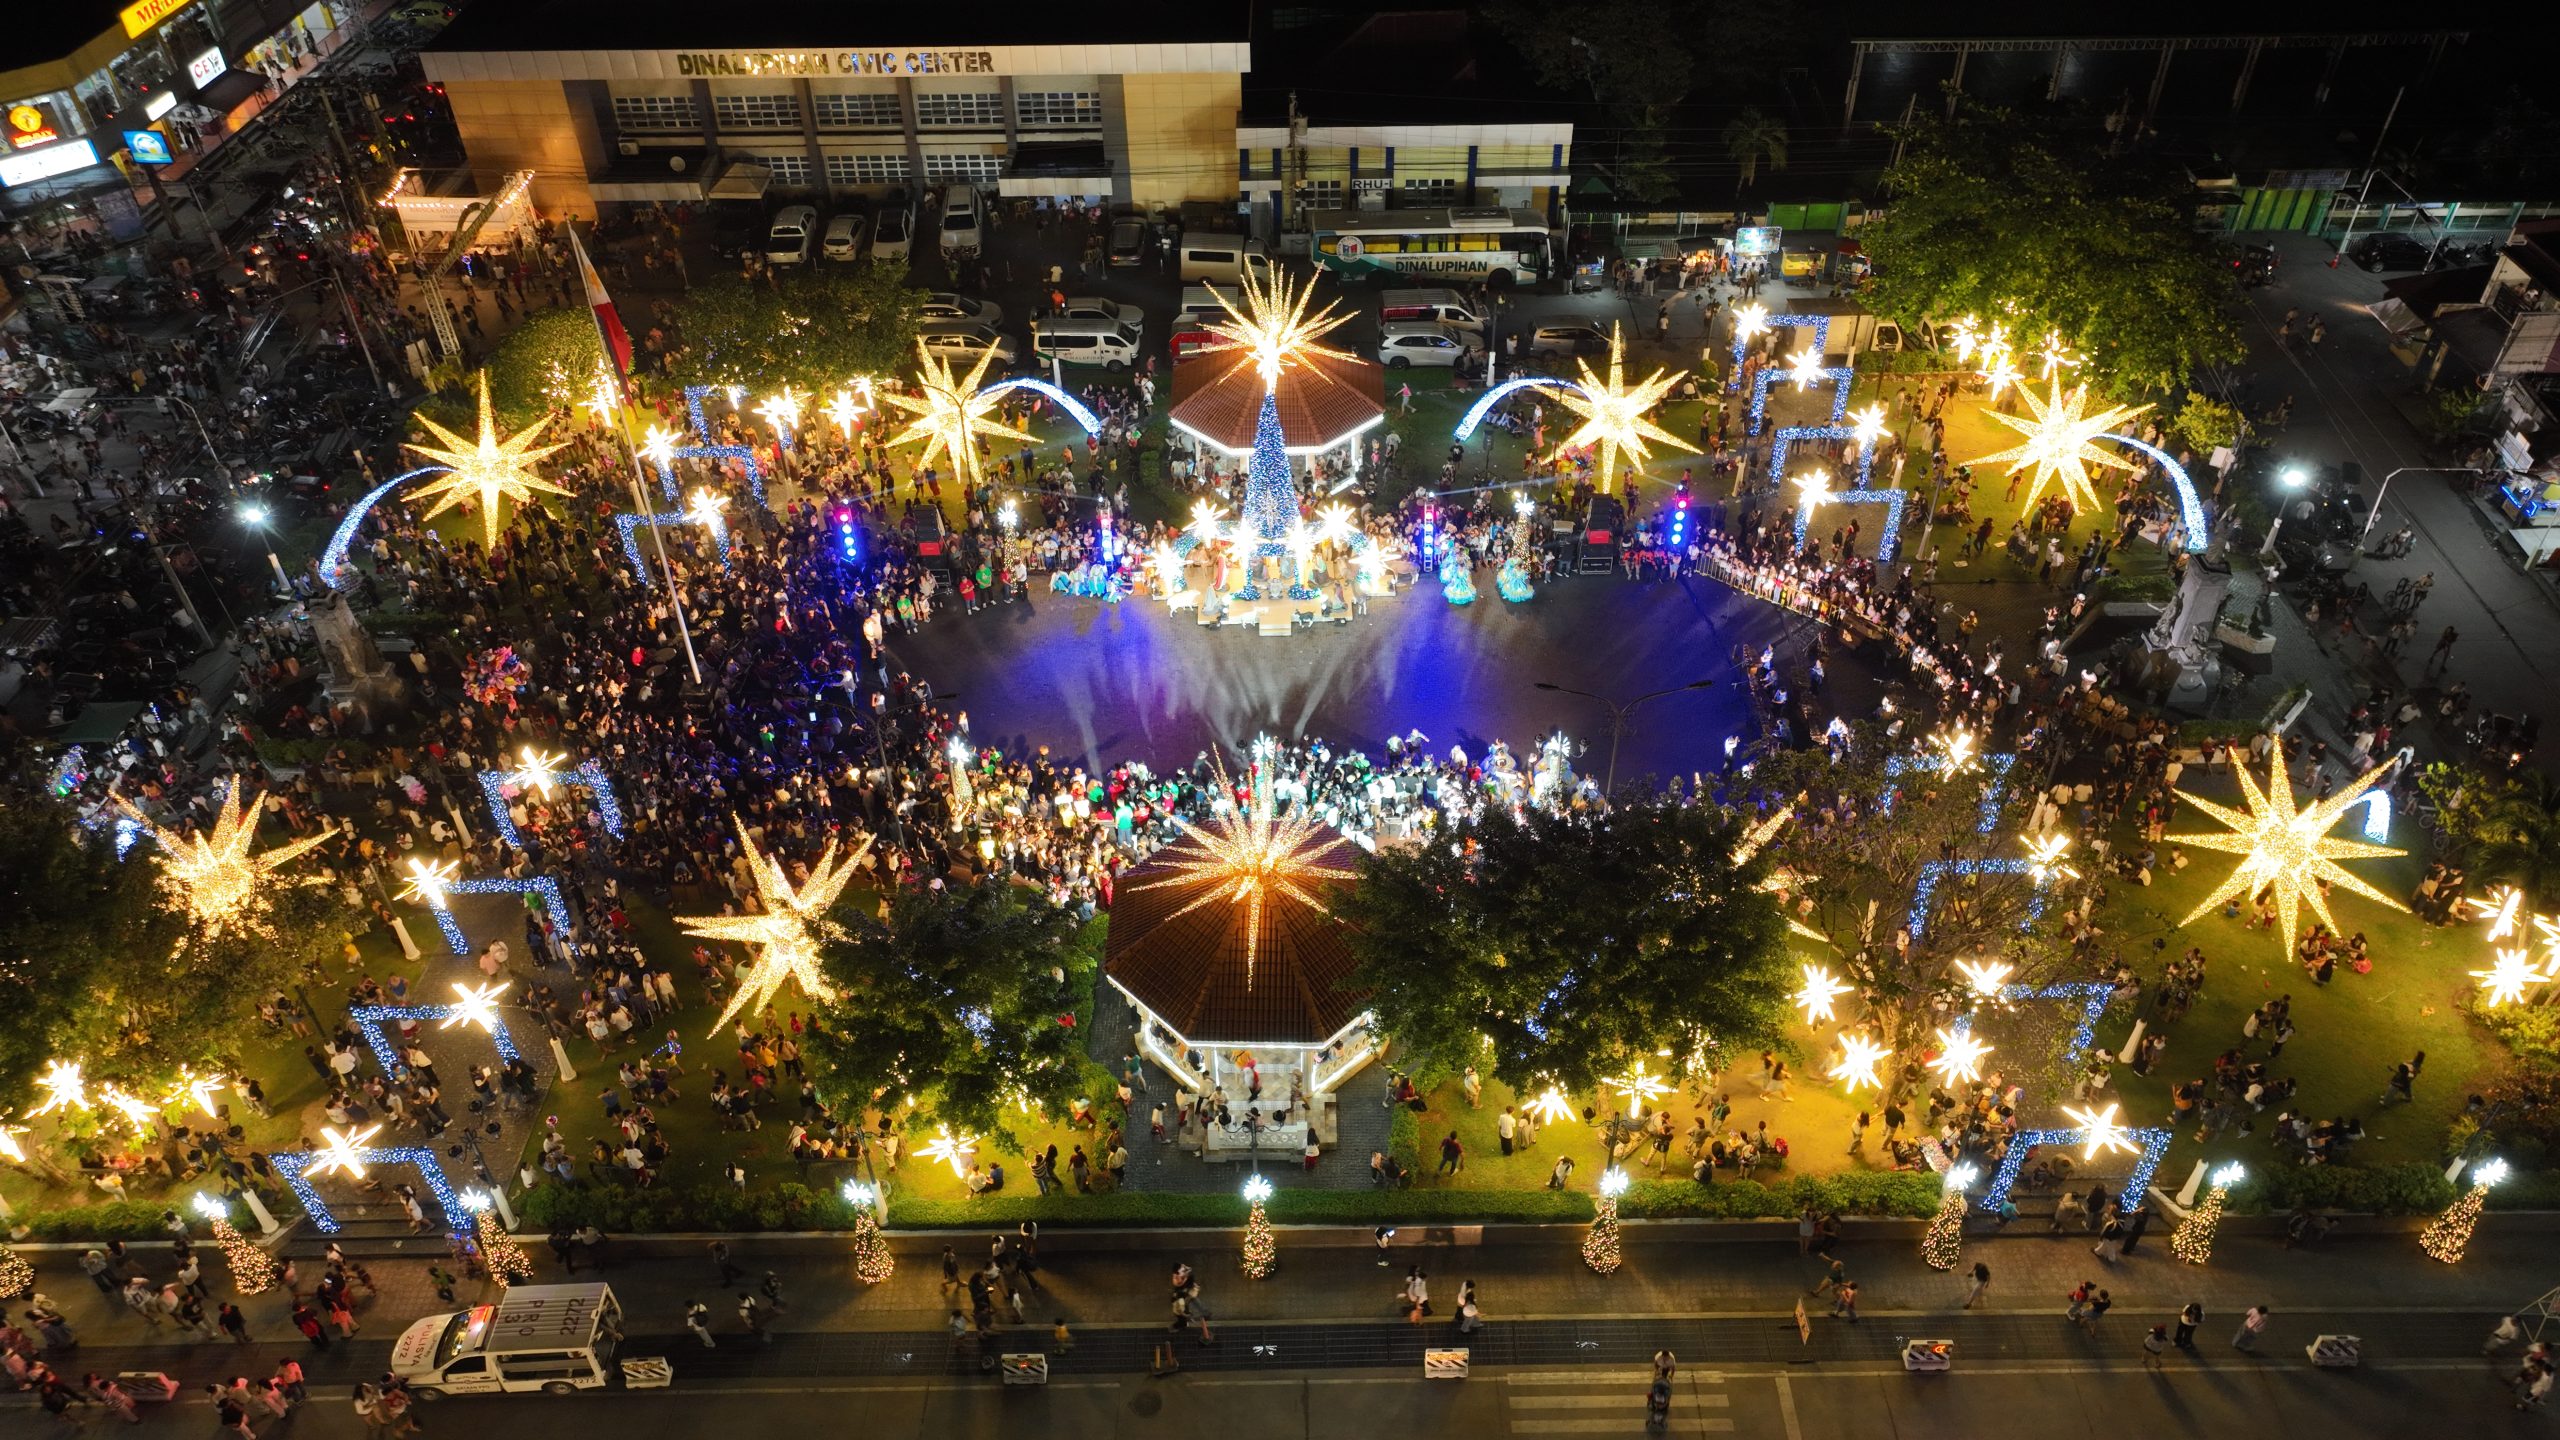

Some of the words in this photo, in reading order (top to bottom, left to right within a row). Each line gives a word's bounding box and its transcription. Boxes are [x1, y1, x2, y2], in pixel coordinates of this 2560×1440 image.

[677, 54, 830, 76] DINALUPIHAN
[837, 52, 898, 74] CIVIC
[905, 52, 994, 73] CENTER
[1395, 261, 1488, 273] DINALUPIHAN
[519, 1300, 544, 1336] PRO
[560, 1298, 586, 1336] 2272
[398, 1335, 414, 1359] 2272
[411, 1323, 434, 1367] PULISYA
